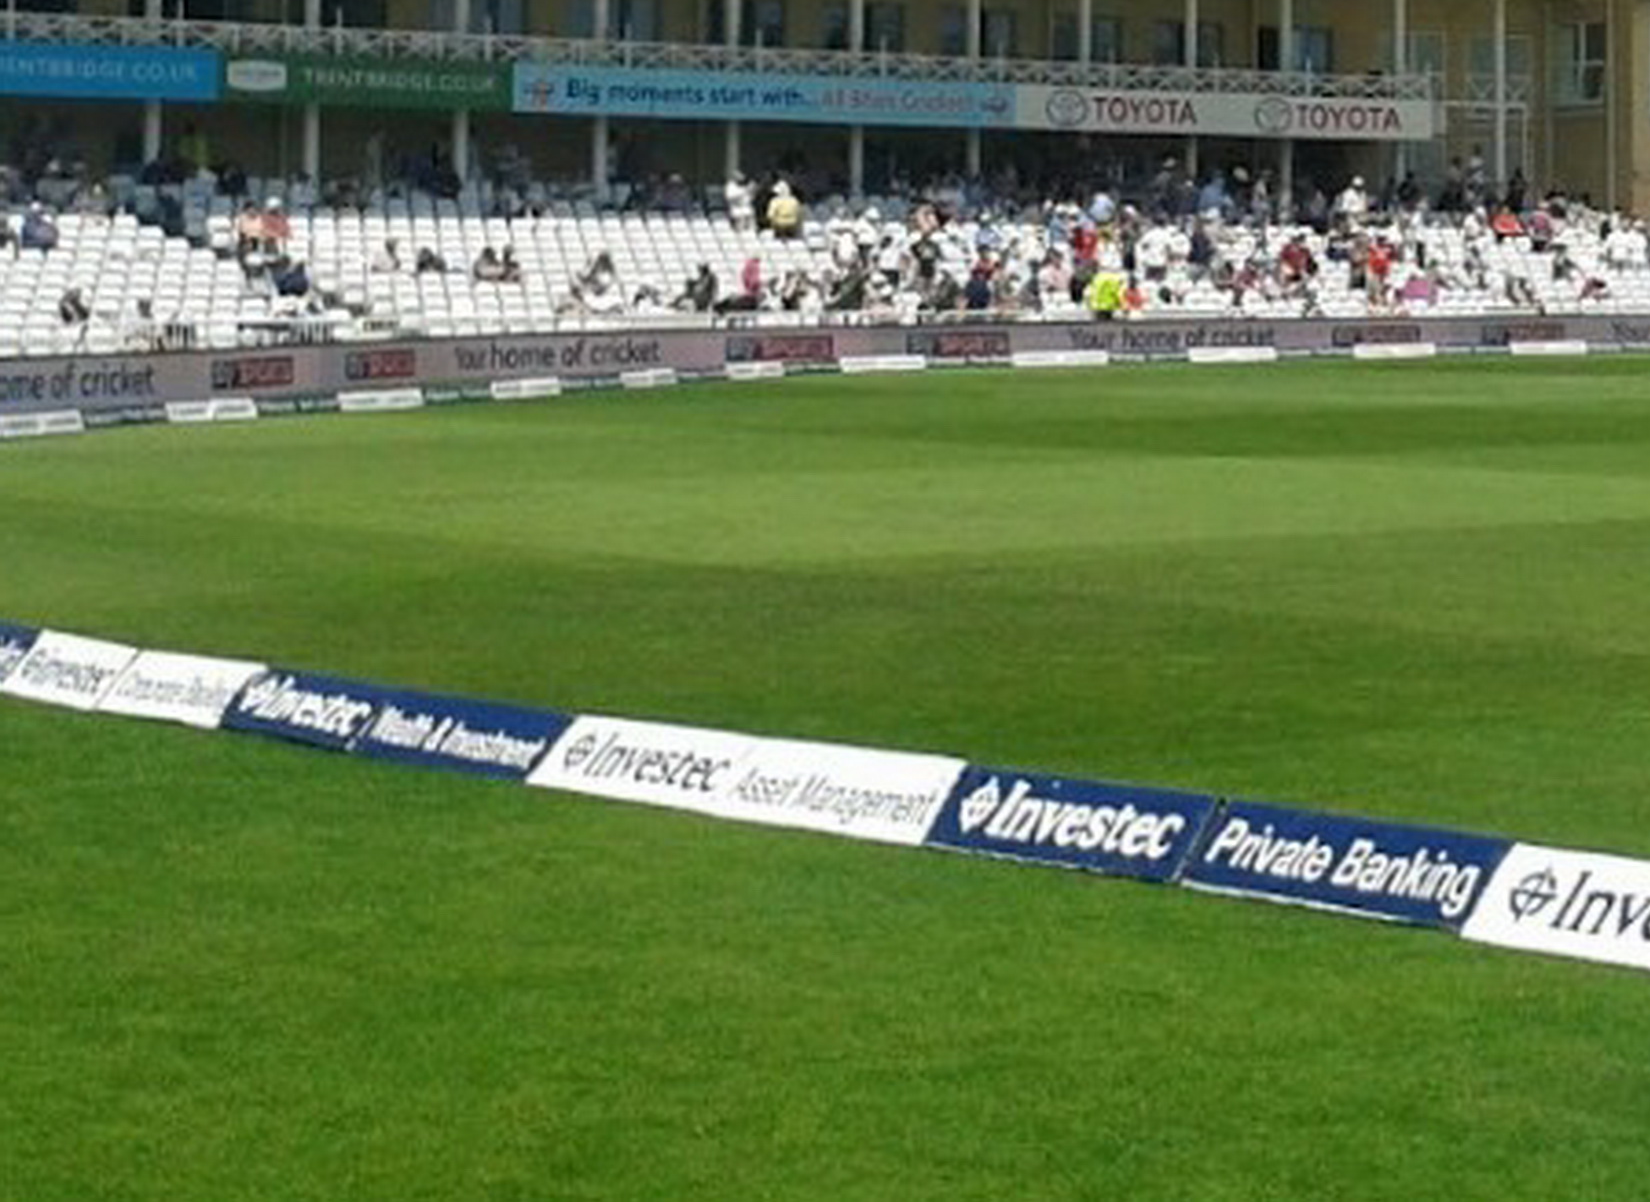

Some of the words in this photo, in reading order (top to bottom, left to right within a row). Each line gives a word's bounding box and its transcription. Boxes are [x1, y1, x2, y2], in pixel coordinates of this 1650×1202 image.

[566, 77, 600, 105] Big
[607, 81, 705, 104] moments
[709, 85, 754, 105] start
[1092, 97, 1197, 125] TOYOTA
[1297, 104, 1402, 132] TOYOTA
[454, 346, 487, 370] Your
[490, 340, 557, 369] home
[560, 339, 586, 368] of
[589, 337, 663, 365] cricket
[51, 362, 77, 399] of
[79, 361, 156, 397] cricket
[587, 732, 730, 792] Investec
[733, 767, 799, 806] Asset
[793, 773, 938, 827] Management
[982, 780, 1188, 860] Investec
[1204, 818, 1334, 881] Private
[1331, 838, 1483, 919] Banking
